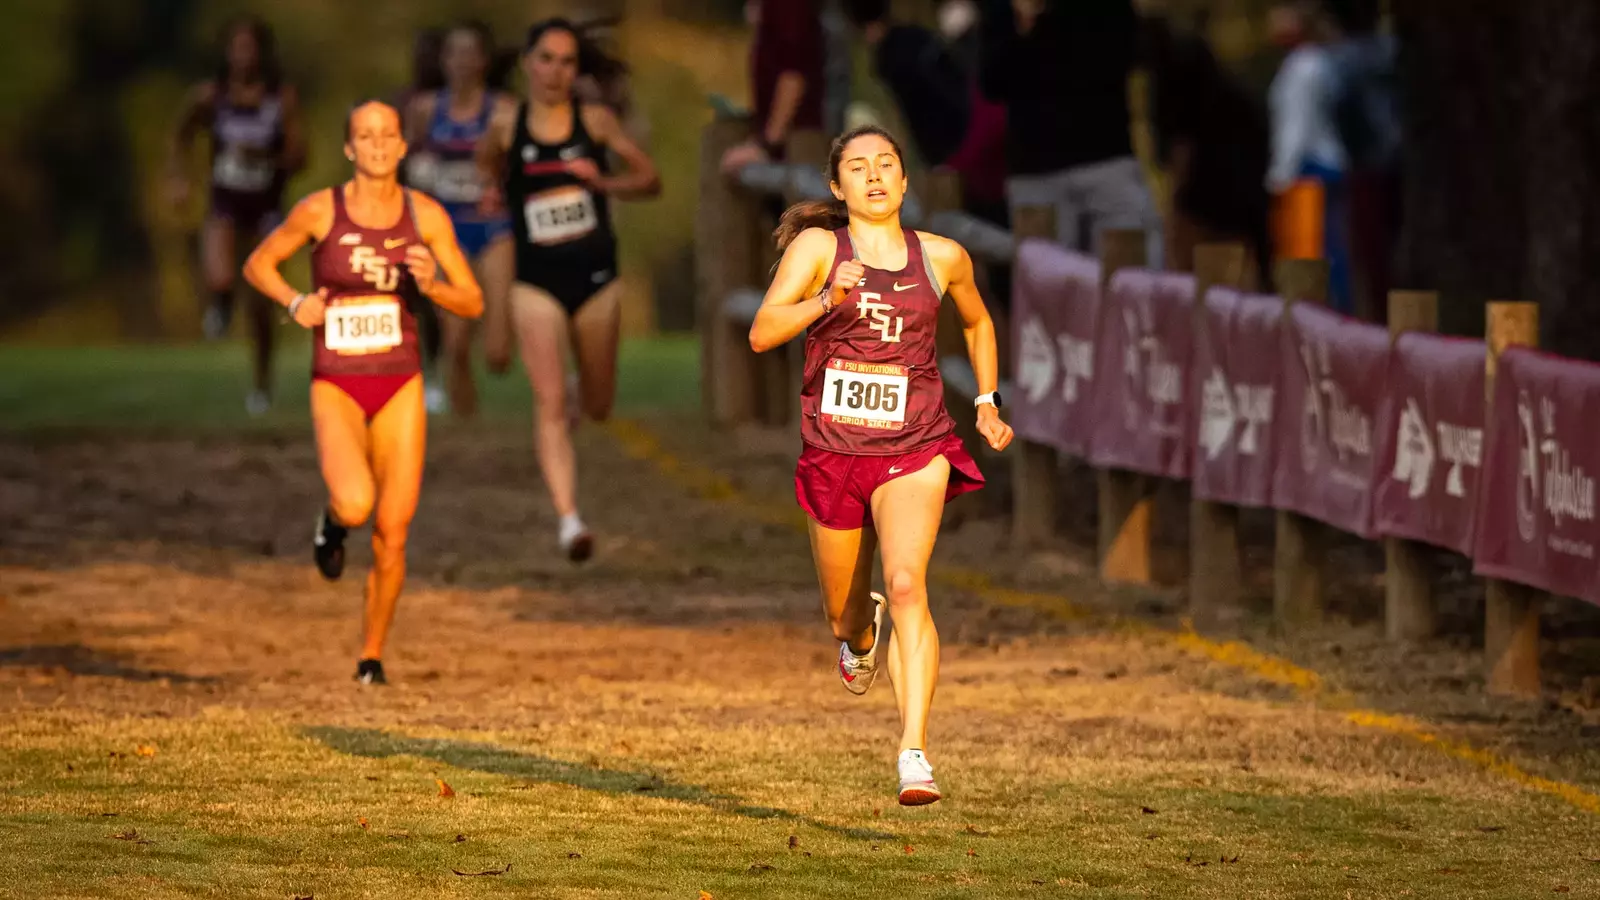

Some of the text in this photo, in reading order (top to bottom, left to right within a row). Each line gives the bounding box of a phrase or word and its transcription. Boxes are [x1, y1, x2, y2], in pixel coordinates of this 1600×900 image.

[349, 246, 399, 291] FSU
[337, 313, 393, 338] 1306
[856, 292, 903, 342] FSU
[844, 362, 902, 375] FSU INVITATIONAL
[833, 378, 900, 412] 1305
[832, 415, 892, 428] FLORIDA STATE
